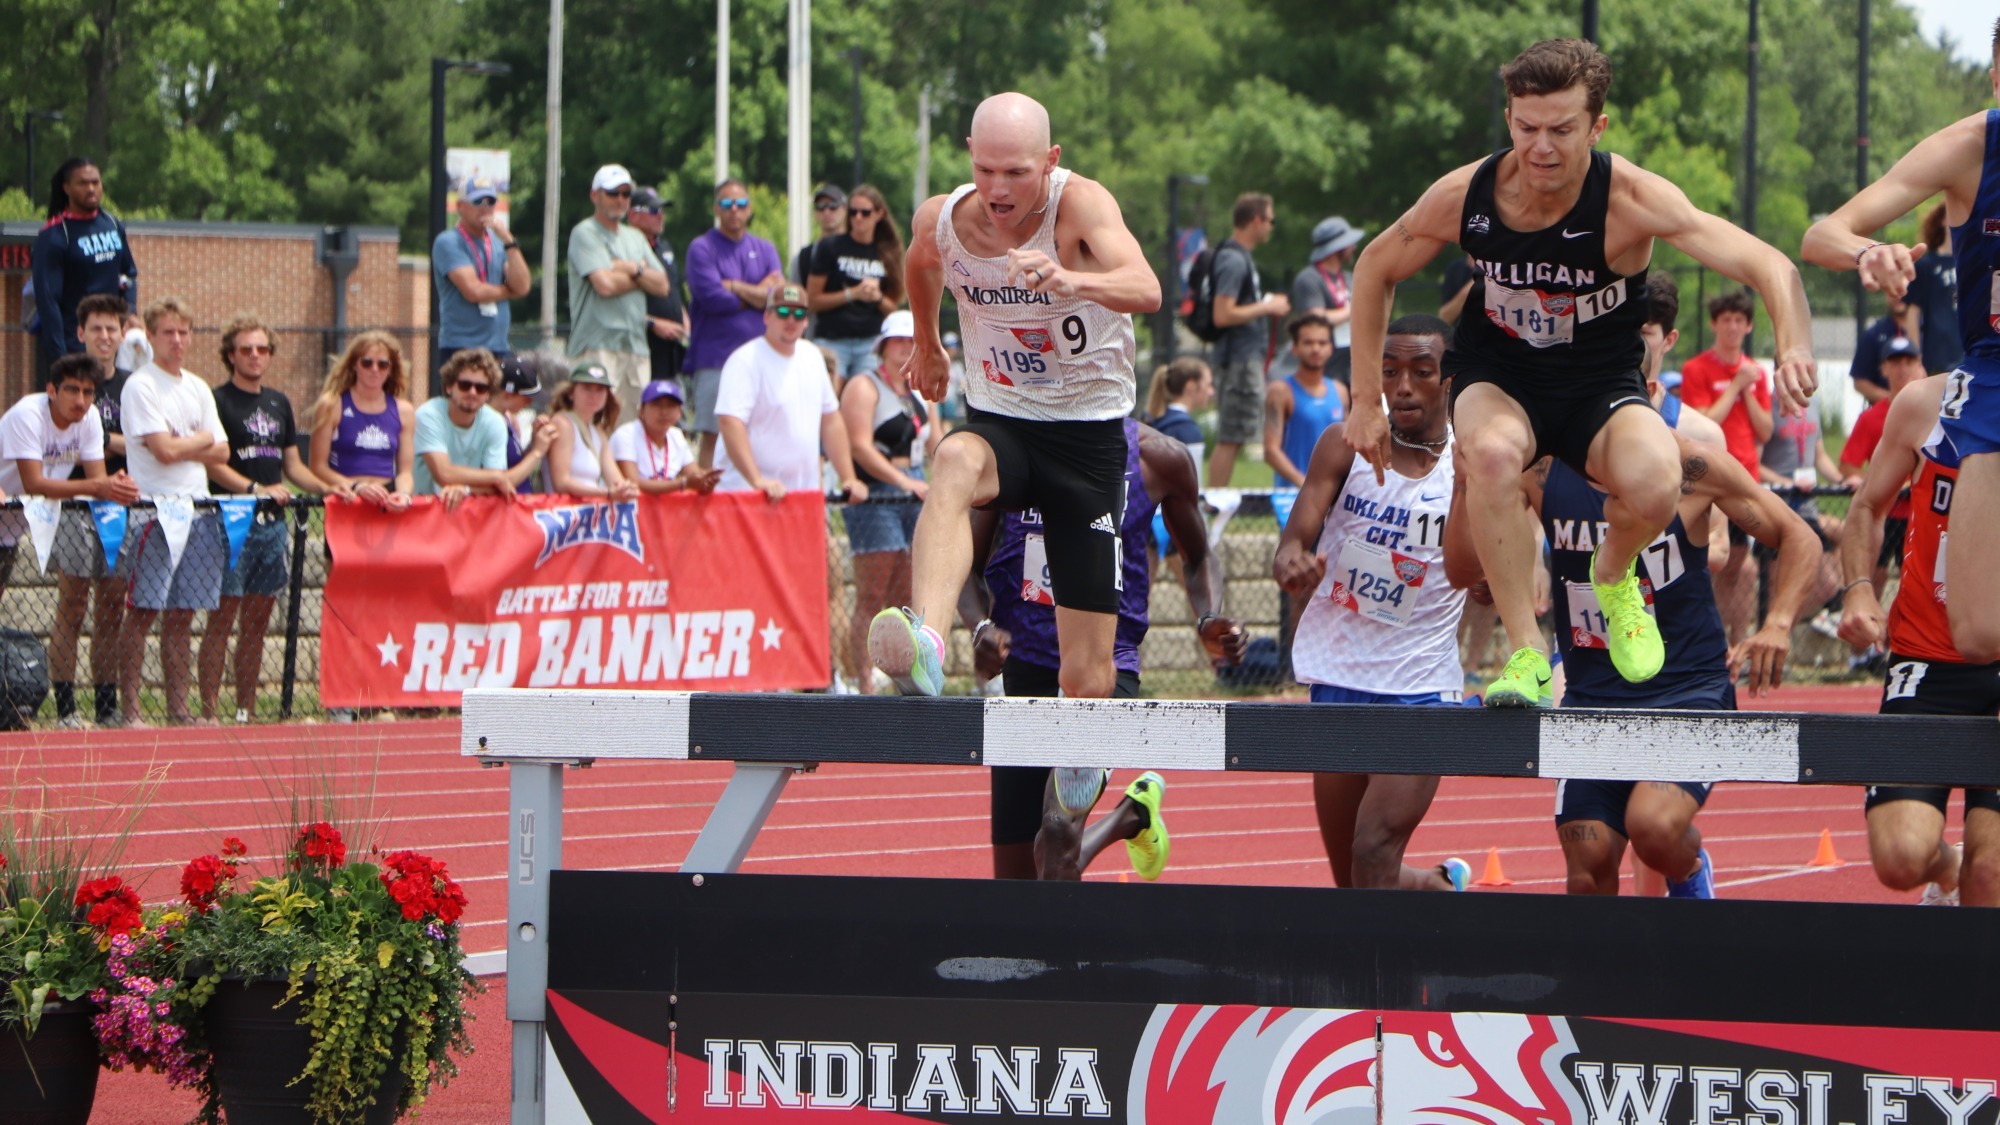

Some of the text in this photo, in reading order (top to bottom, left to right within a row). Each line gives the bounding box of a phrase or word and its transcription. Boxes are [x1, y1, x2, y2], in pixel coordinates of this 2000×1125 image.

[0, 244, 31, 270] ETS
[78, 230, 122, 256] RAMS
[837, 256, 886, 278] TAYLO
[1585, 285, 1618, 317] 10
[1061, 315, 1087, 355] 9
[1496, 303, 1555, 336] 1181
[989, 346, 1047, 374] 1195
[1343, 494, 1411, 528] OKLAH
[533, 499, 644, 570] NAIA
[1090, 522, 1116, 535] adida
[1366, 526, 1412, 552] CIT
[1417, 513, 1446, 547] 11
[1648, 540, 1670, 584] 7
[495, 579, 669, 616] BATTLE FOR THE
[1348, 567, 1405, 608] 1254
[1580, 609, 1608, 634] 11
[402, 609, 755, 692] RED BANNER
[520, 813, 535, 882] UCS
[703, 1038, 1112, 1118] INDIANA
[1574, 1061, 2000, 1125] WESLEY
